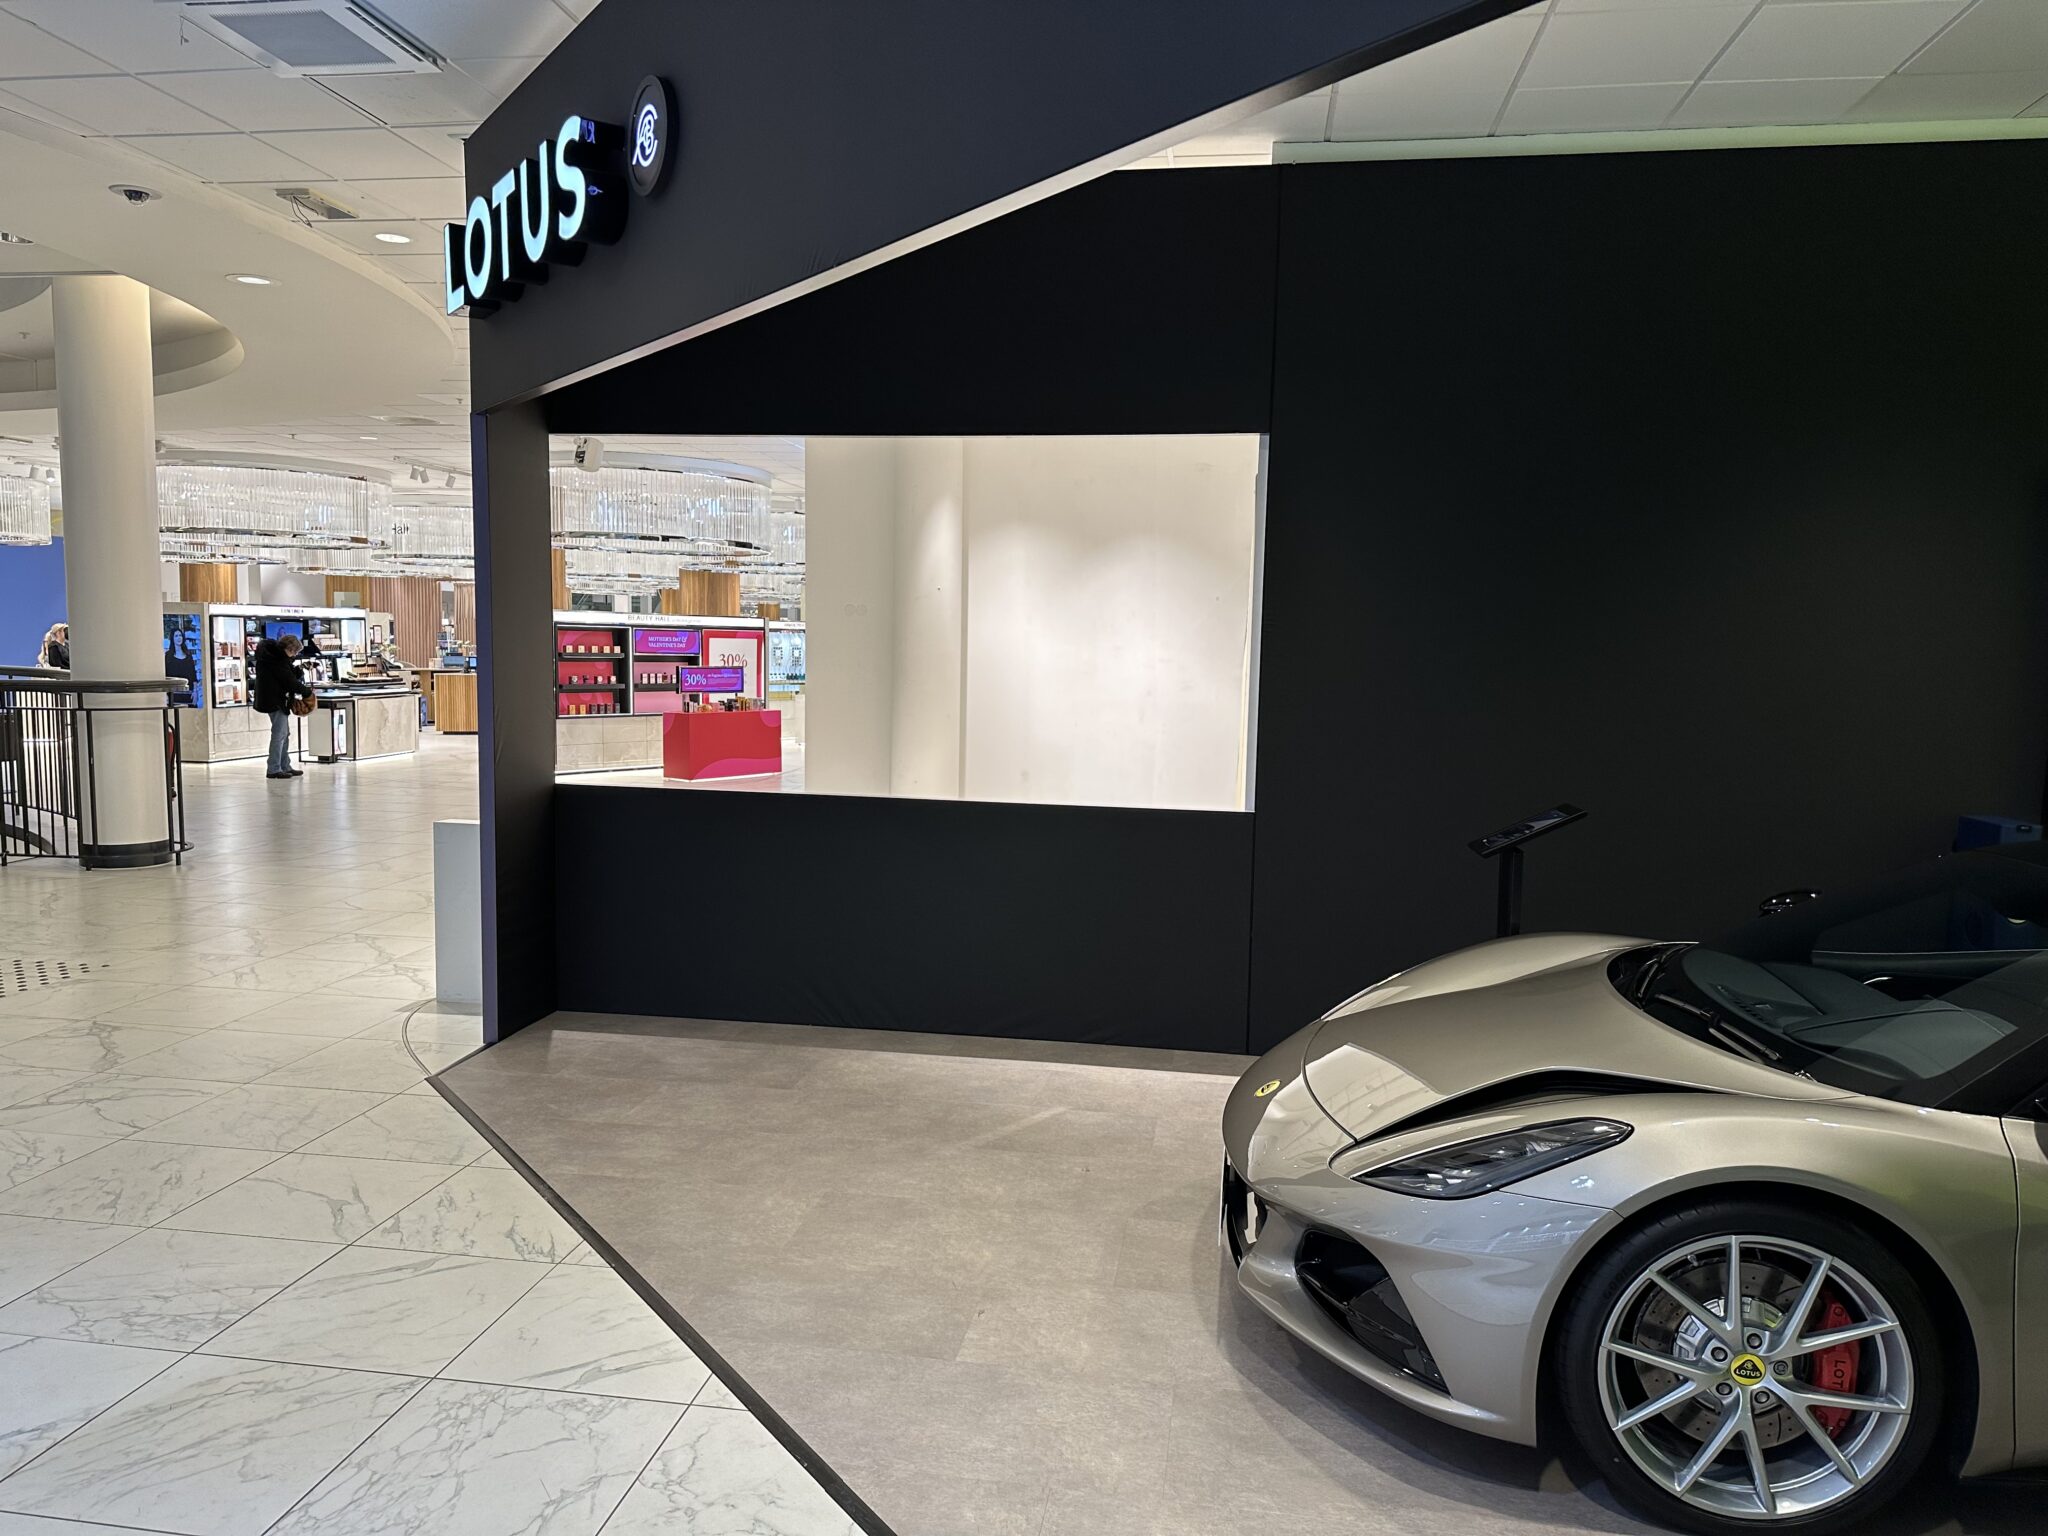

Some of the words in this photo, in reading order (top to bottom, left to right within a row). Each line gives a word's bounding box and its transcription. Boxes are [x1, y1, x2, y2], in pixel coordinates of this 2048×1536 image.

[444, 115, 586, 315] LOTUS
[719, 653, 748, 668] 30%
[684, 673, 707, 686] 30%
[1735, 1368, 1761, 1378] LOTUS
[1832, 1360, 1847, 1390] LOT
